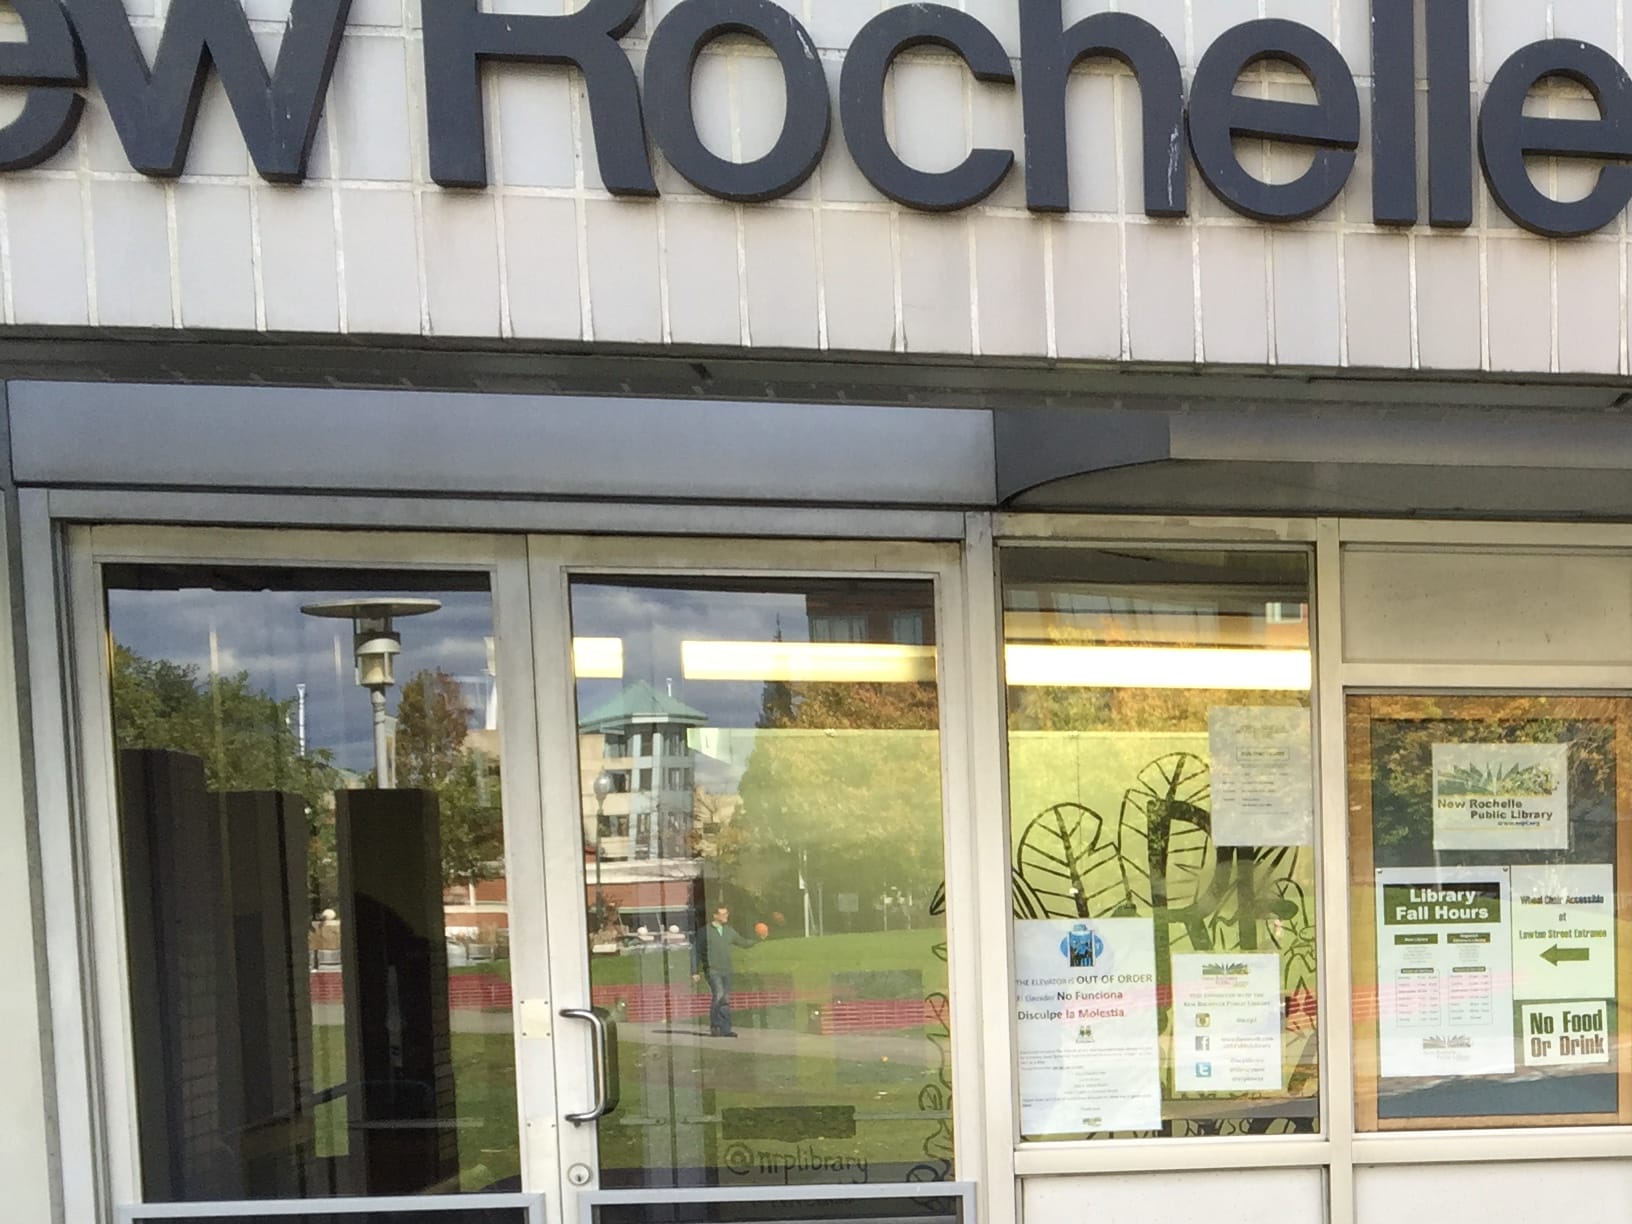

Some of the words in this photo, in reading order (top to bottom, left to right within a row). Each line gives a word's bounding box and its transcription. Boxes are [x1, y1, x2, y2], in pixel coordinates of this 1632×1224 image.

[1437, 799, 1466, 809] New
[1469, 798, 1523, 809] Rochelle
[1470, 810, 1507, 820] Public
[1511, 810, 1553, 821] Library
[1409, 888, 1476, 905] Library
[1565, 894, 1605, 905] Accessible
[1395, 906, 1429, 921] Fall
[1434, 905, 1489, 920] Hours
[1558, 912, 1567, 922] at
[1548, 929, 1572, 939] Street
[1574, 928, 1607, 939] Entrance
[1076, 975, 1099, 985] OUT
[1101, 974, 1115, 985] OF
[1117, 974, 1153, 983] ORDER
[1057, 992, 1073, 1001] No
[1075, 991, 1123, 1000] Funciona
[1017, 1010, 1063, 1021] Disculpe
[1066, 1009, 1076, 1019] la
[1078, 1008, 1125, 1019] Molestia
[1529, 1012, 1554, 1035] No
[1562, 1009, 1603, 1033] Food
[1531, 1037, 1552, 1058] Or
[1559, 1034, 1605, 1057] Drink
[724, 1142, 869, 1184] @nrplibrary
